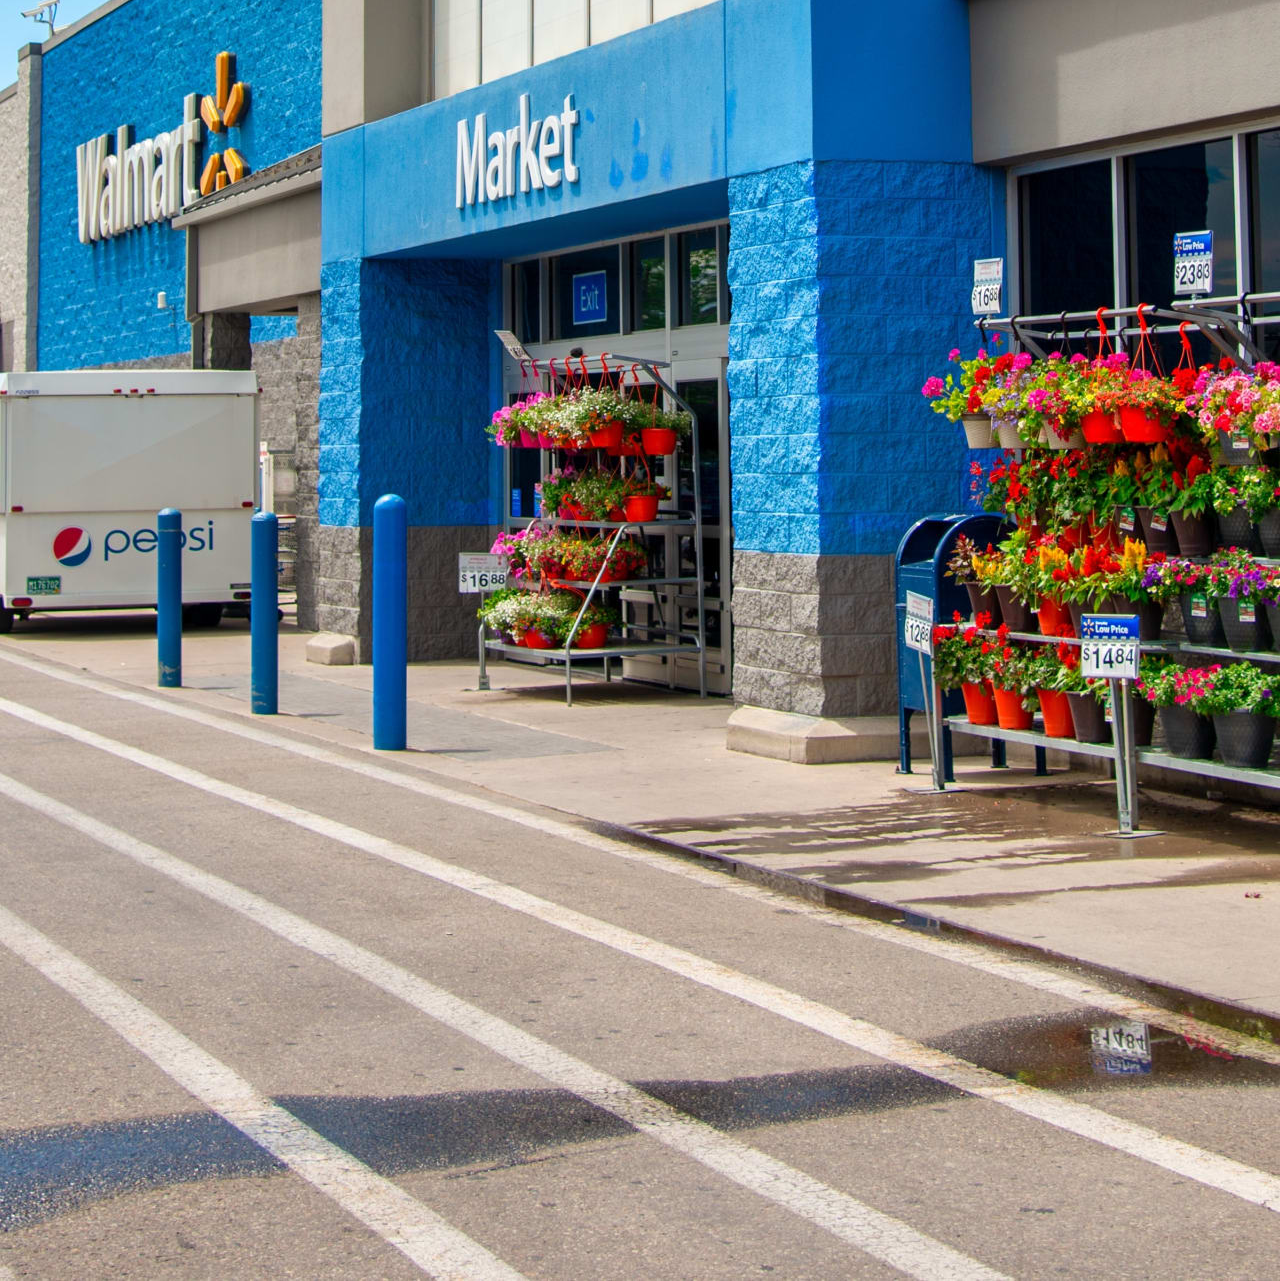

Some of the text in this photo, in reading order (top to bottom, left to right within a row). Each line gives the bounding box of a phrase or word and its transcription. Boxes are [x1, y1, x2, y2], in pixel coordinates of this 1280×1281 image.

[456, 93, 580, 209] Market
[77, 93, 201, 244] Walmart
[1193, 241, 1205, 250] Price
[580, 284, 599, 312] Exit
[104, 520, 214, 561] pesi
[1095, 625, 1129, 634] Low Price
